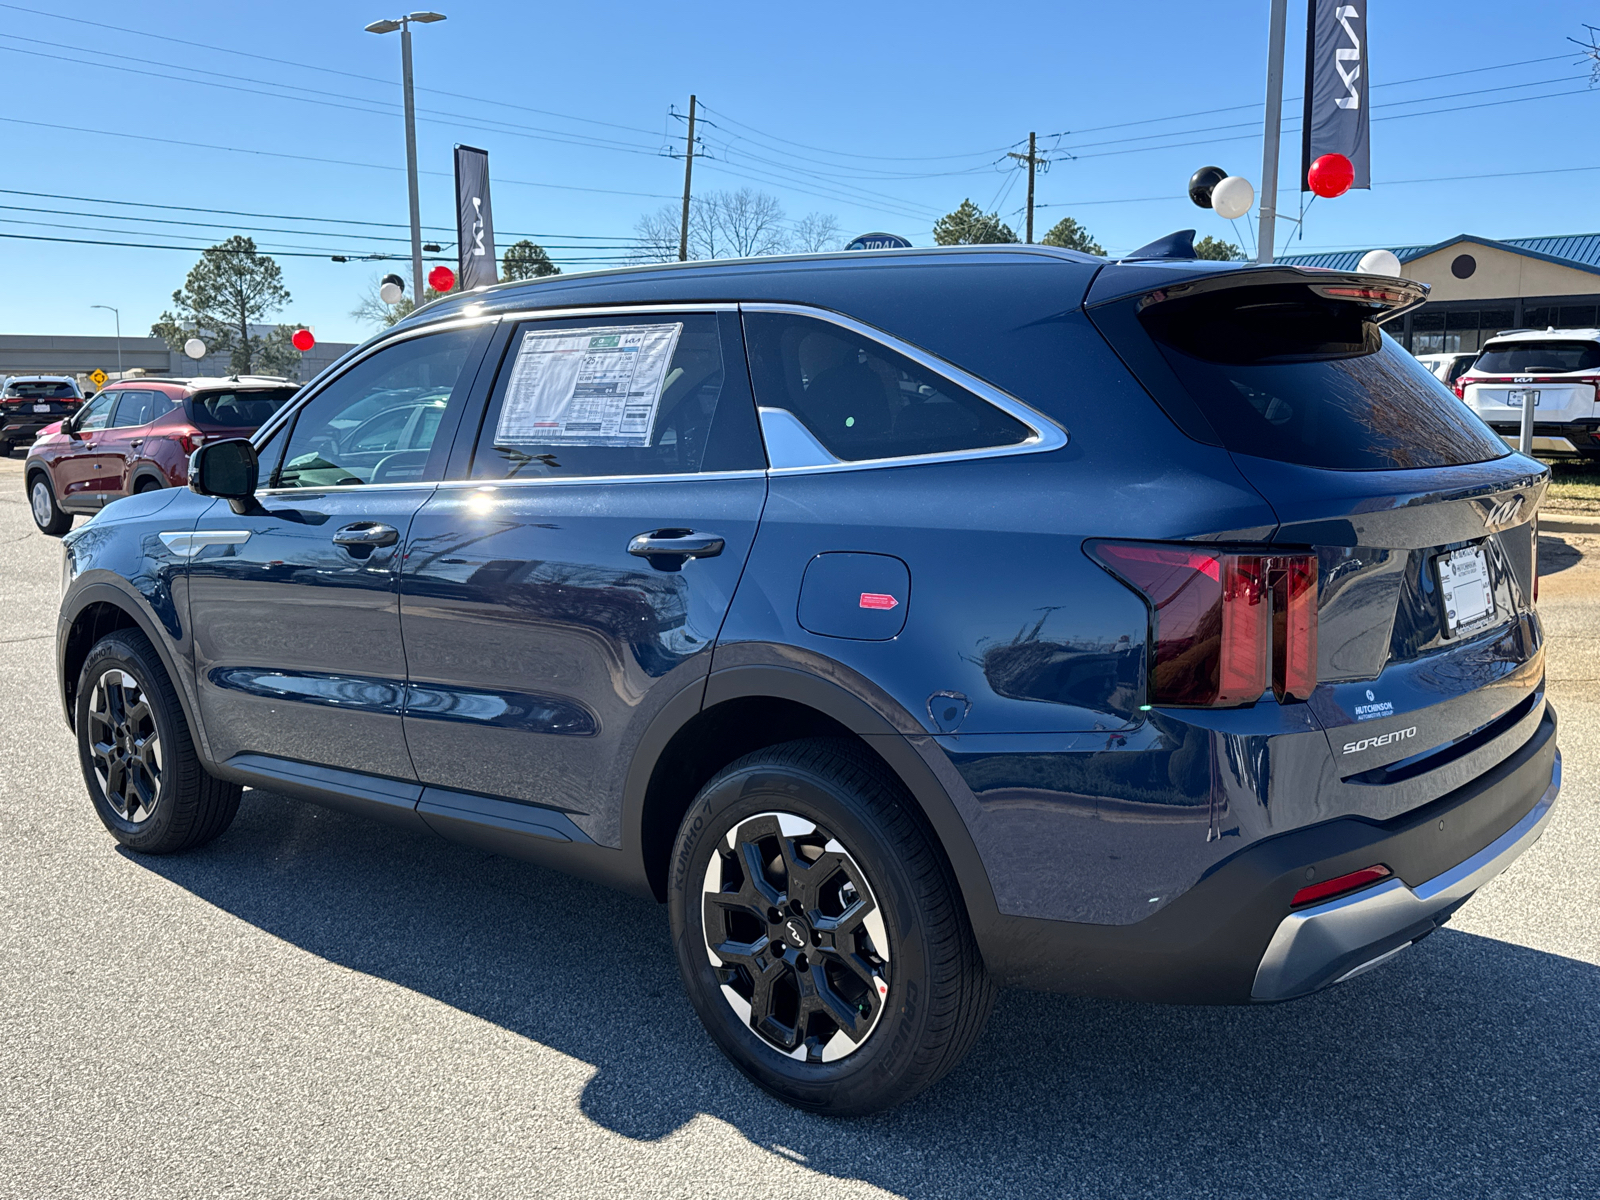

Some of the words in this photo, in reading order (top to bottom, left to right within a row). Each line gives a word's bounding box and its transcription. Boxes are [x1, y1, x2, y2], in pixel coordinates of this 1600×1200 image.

[1335, 5, 1360, 110] KIA
[1355, 701, 1393, 715] HUTCHINSON
[1357, 712, 1381, 721] AUTOMOTIVE
[1342, 726, 1417, 755] SORENTO
[674, 816, 704, 892] KUMHO
